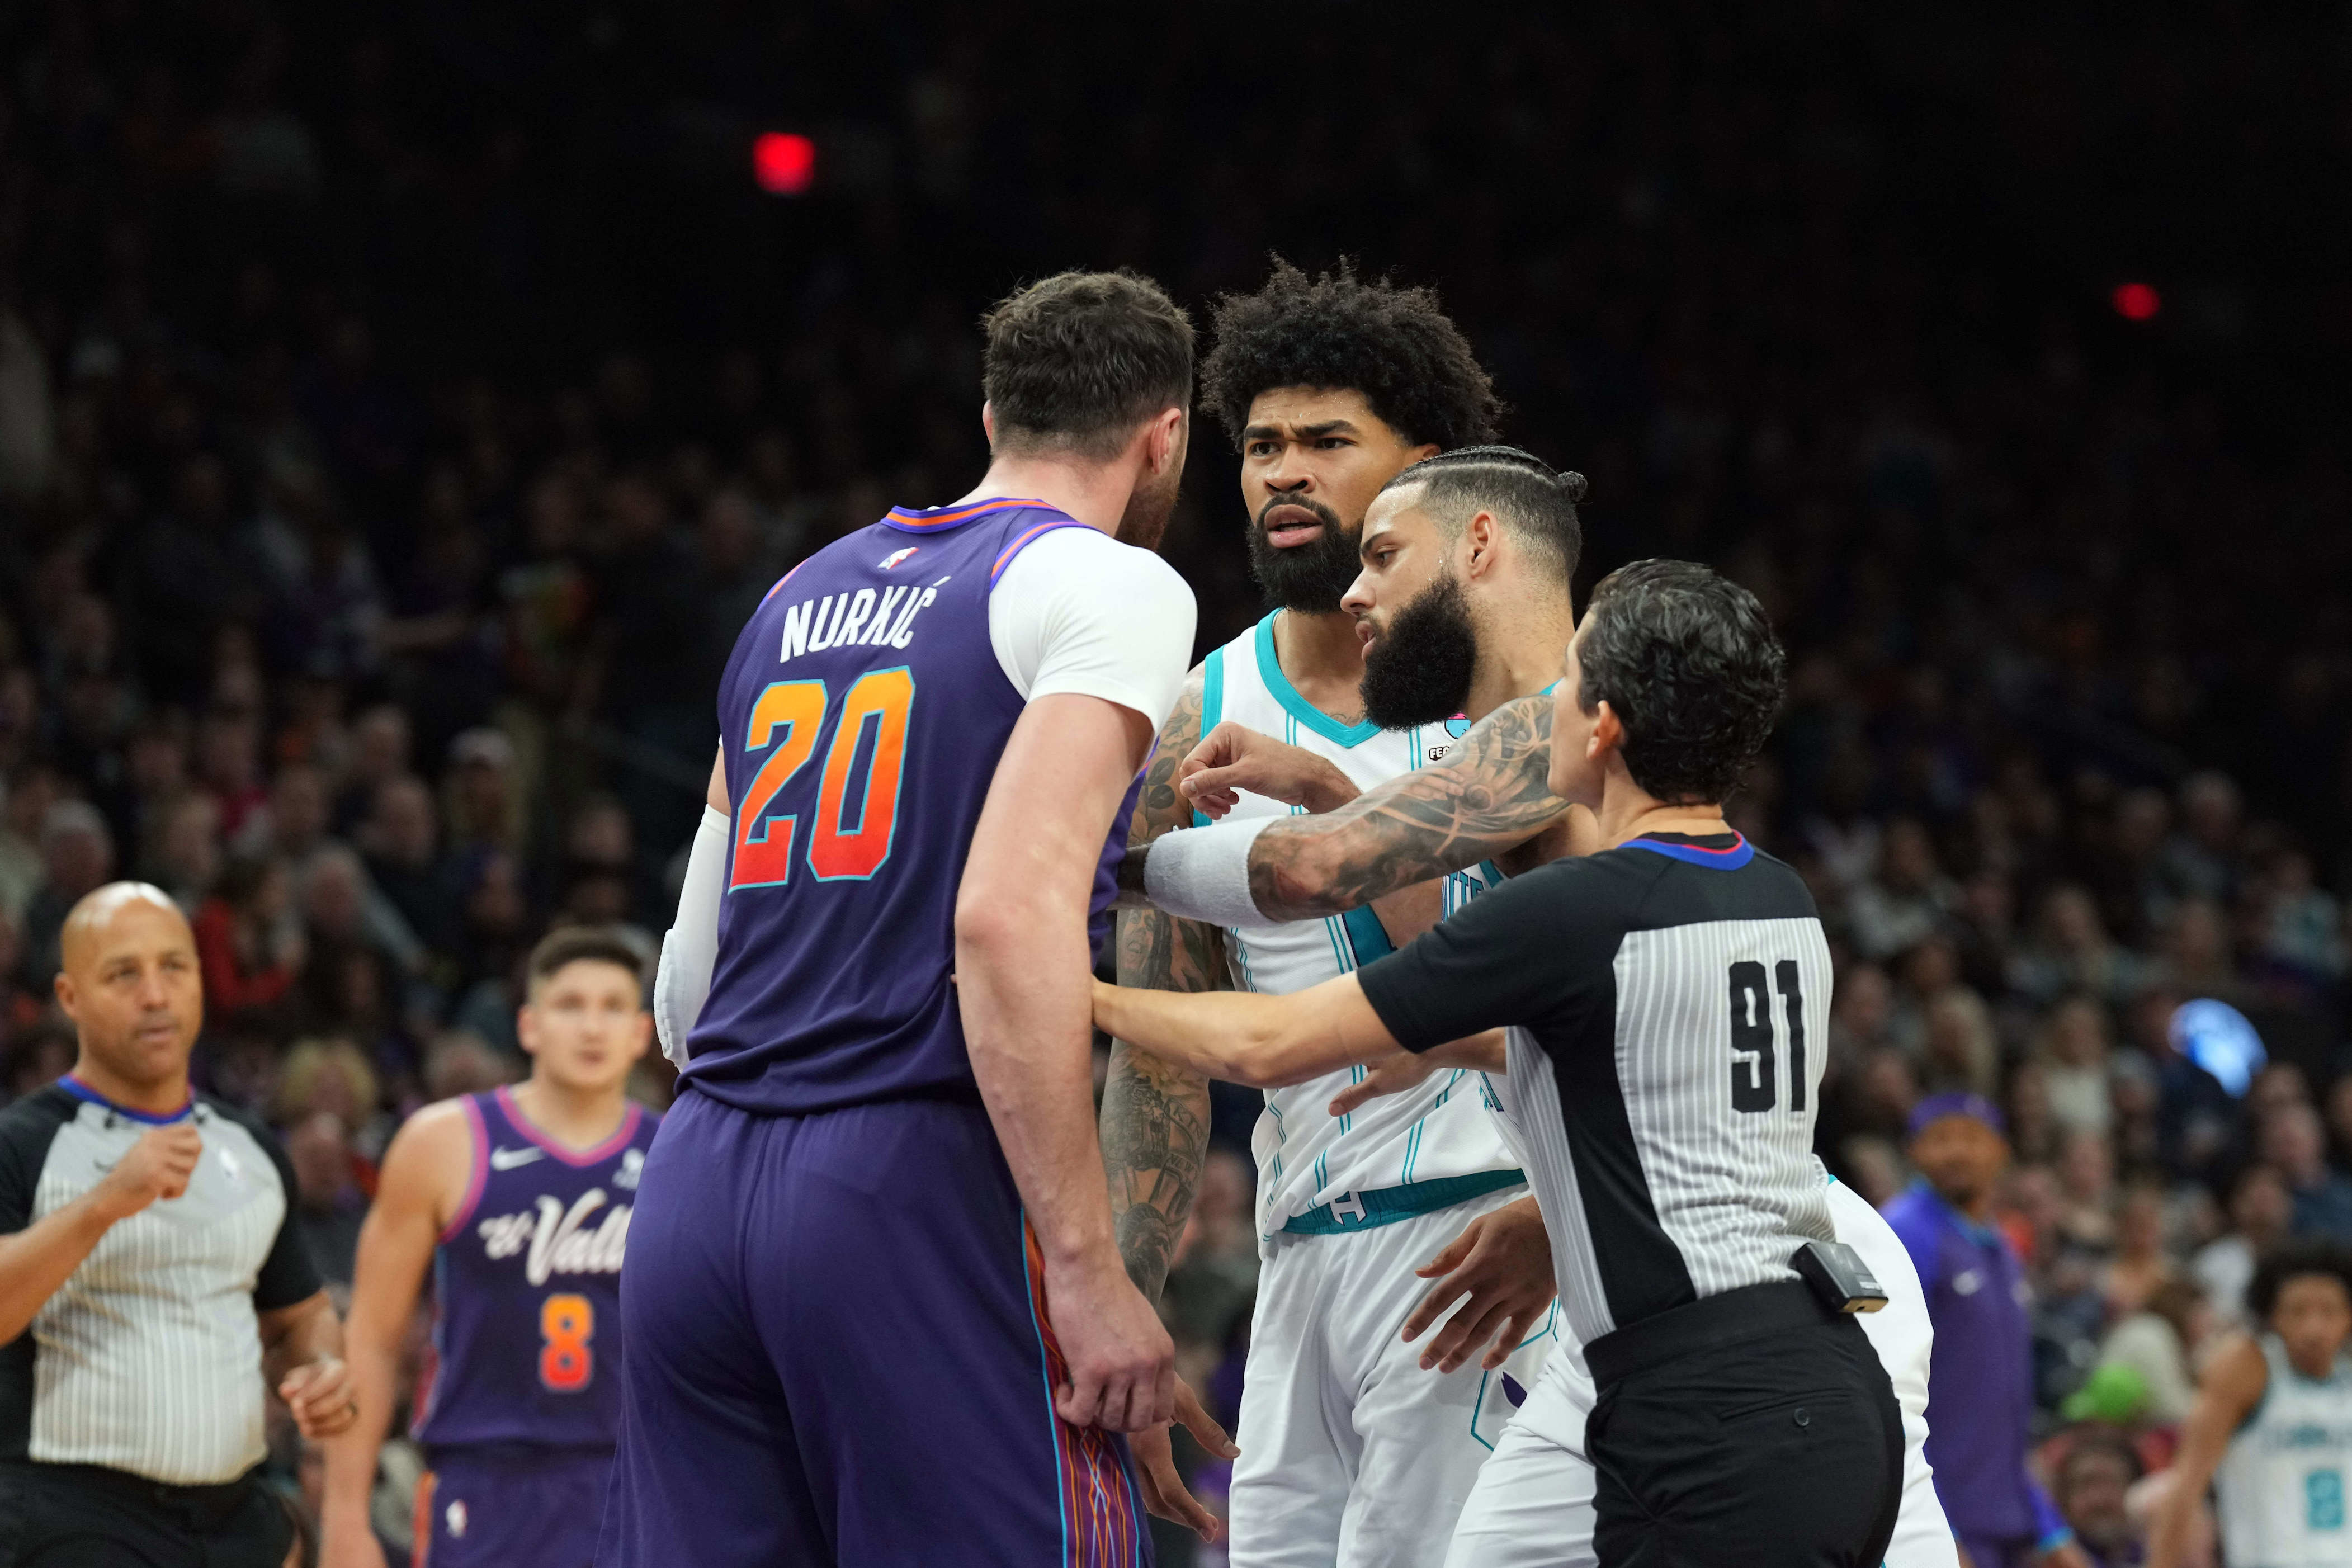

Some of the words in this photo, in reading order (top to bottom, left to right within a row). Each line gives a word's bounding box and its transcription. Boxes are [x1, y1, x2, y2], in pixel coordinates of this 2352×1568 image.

[780, 575, 951, 664] NURKIĆ
[728, 665, 916, 895] 20
[1729, 960, 1806, 1113] 91
[540, 1293, 594, 1392] 8
